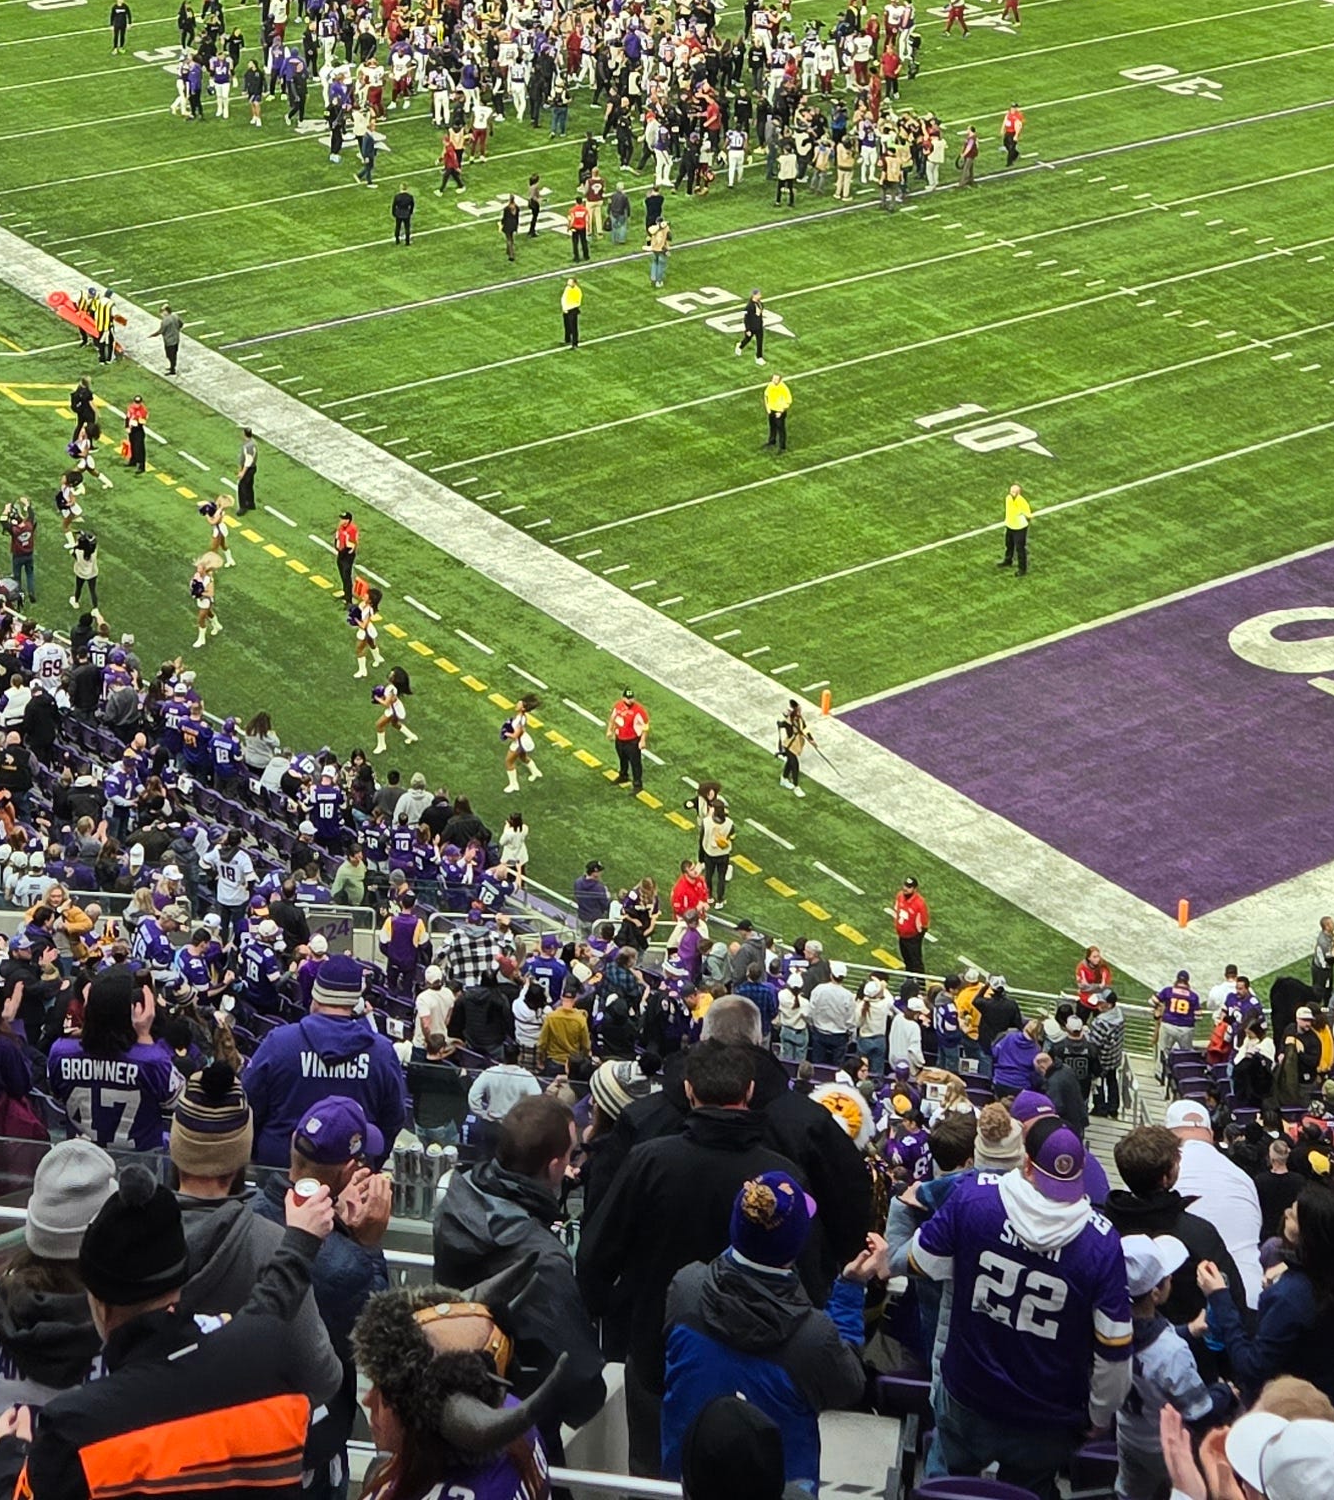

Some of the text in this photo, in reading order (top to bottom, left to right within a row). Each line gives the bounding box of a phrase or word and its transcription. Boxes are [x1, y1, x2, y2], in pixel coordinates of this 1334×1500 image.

[41, 659, 64, 678] 69
[219, 862, 237, 880] 18
[61, 1057, 139, 1086] BROWNER
[68, 1087, 142, 1150] 47
[971, 1250, 1068, 1340] 22
